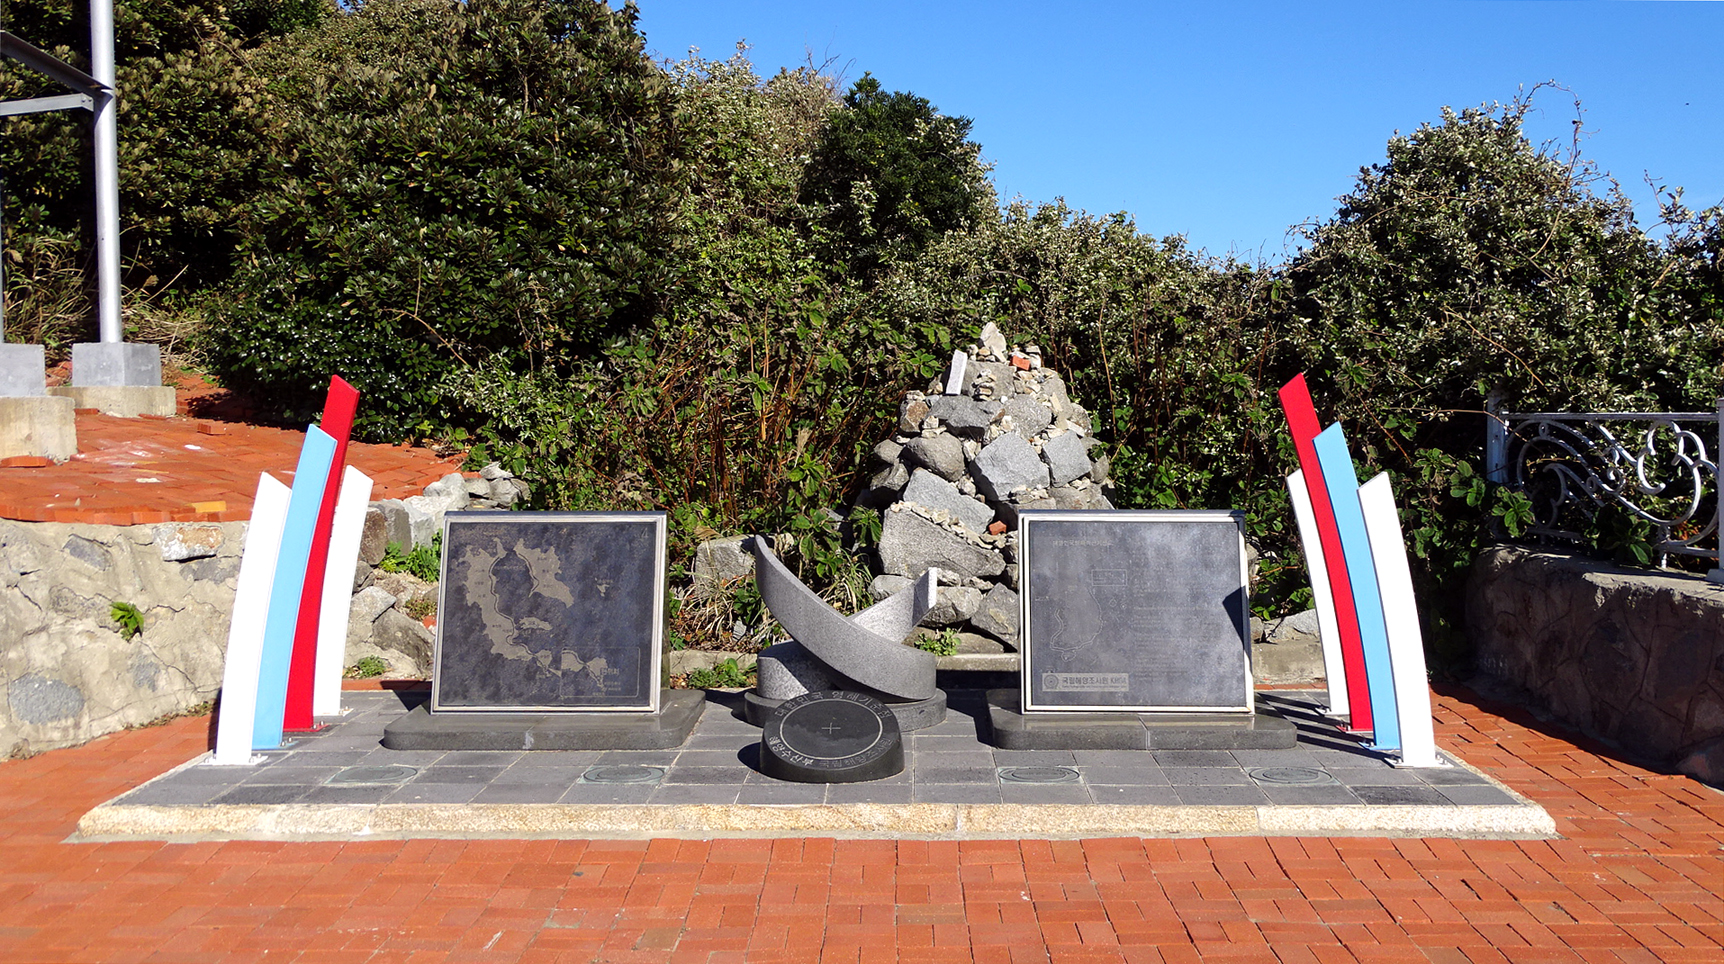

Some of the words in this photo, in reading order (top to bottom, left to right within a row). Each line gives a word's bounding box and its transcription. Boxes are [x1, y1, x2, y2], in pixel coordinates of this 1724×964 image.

[1062, 676, 1109, 685] 국립해양조사원
[774, 691, 824, 717] 대한민국
[831, 690, 893, 719] 영해기준점
[769, 736, 814, 766] 해양수산부
[819, 738, 894, 768] 국립해양조사원
